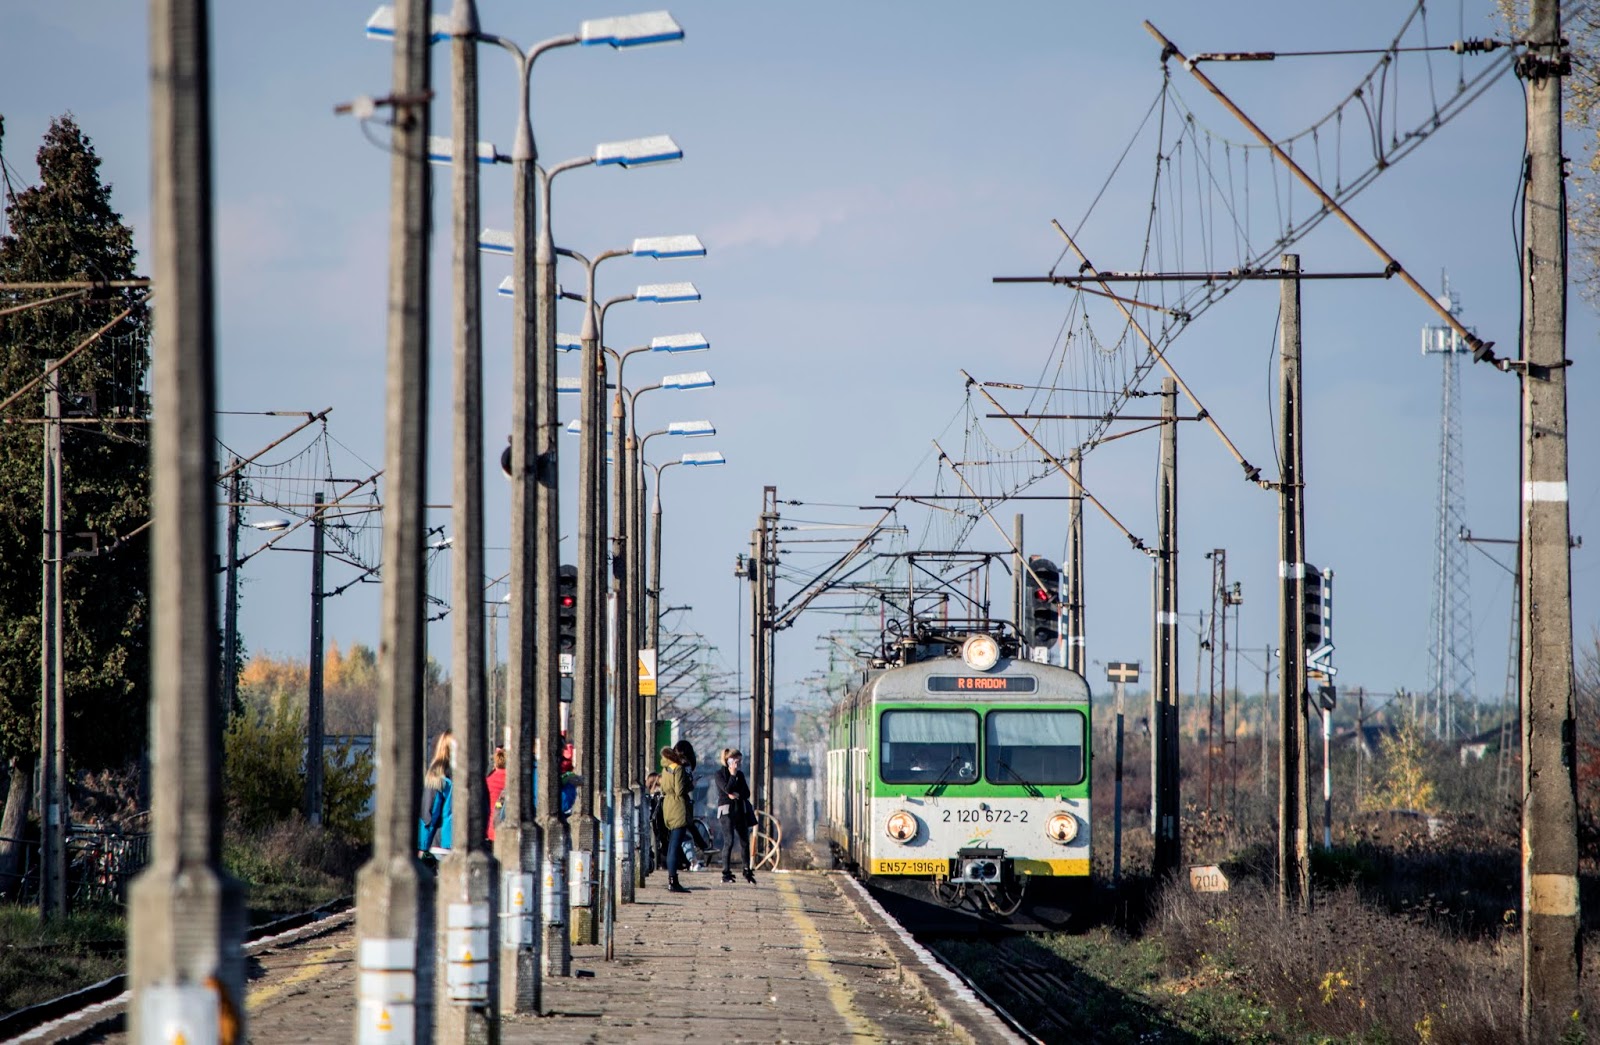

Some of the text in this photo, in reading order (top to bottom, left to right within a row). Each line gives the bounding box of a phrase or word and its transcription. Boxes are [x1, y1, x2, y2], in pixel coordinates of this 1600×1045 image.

[958, 678, 1006, 688] R 8 RADOM
[943, 809, 1028, 823] 2 120 672-2
